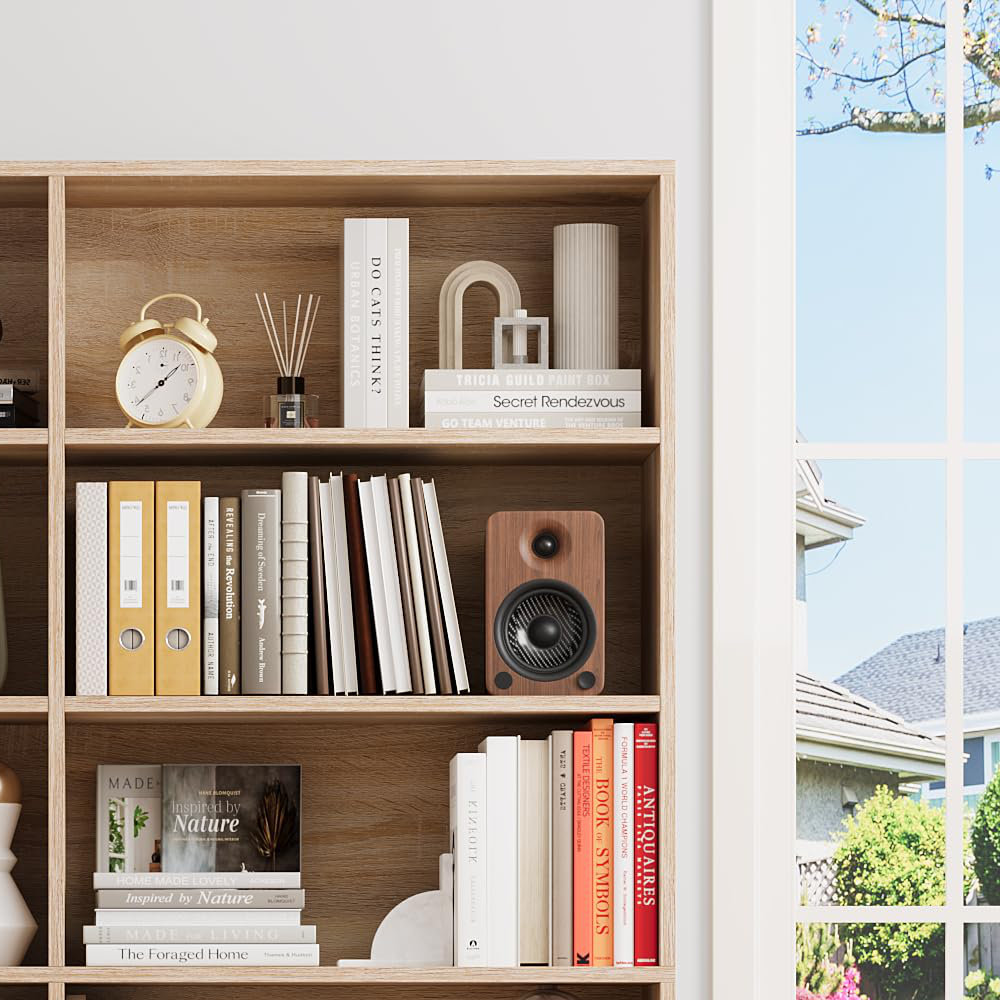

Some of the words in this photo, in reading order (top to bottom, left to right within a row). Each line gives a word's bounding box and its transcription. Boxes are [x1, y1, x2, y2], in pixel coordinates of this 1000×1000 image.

[371, 257, 381, 279] DO
[371, 287, 381, 327] CATS
[371, 335, 381, 394] THINK?
[493, 395, 537, 408] Secret
[541, 395, 626, 408] Rendezvous
[225, 507, 235, 553] REVEALING
[256, 513, 266, 552] Dreaming
[257, 561, 266, 592] Sweden
[225, 568, 235, 620] Revolution
[258, 637, 266, 660] Andrew
[258, 662, 266, 683] Brown
[582, 744, 590, 774] TEXTILE
[595, 757, 603, 774] THE
[620, 736, 628, 774] FORMULA
[108, 777, 153, 790] MADE
[582, 776, 590, 818] DESIGNERS
[620, 783, 628, 810] WORLD
[172, 800, 222, 816] Inspired
[226, 800, 241, 817] by
[595, 778, 610, 829] BOOK
[173, 815, 240, 833] Nature
[595, 832, 603, 844] OF
[620, 813, 628, 859] CHAMPIONS
[640, 784, 656, 906] ANTIQUAIRES
[125, 893, 173, 905] Inspired
[178, 893, 193, 906] by
[196, 891, 254, 905] Nature
[595, 847, 611, 936] SYMBOLS
[119, 948, 144, 960] The
[148, 948, 204, 962] Foraged
[208, 948, 249, 960] Home
